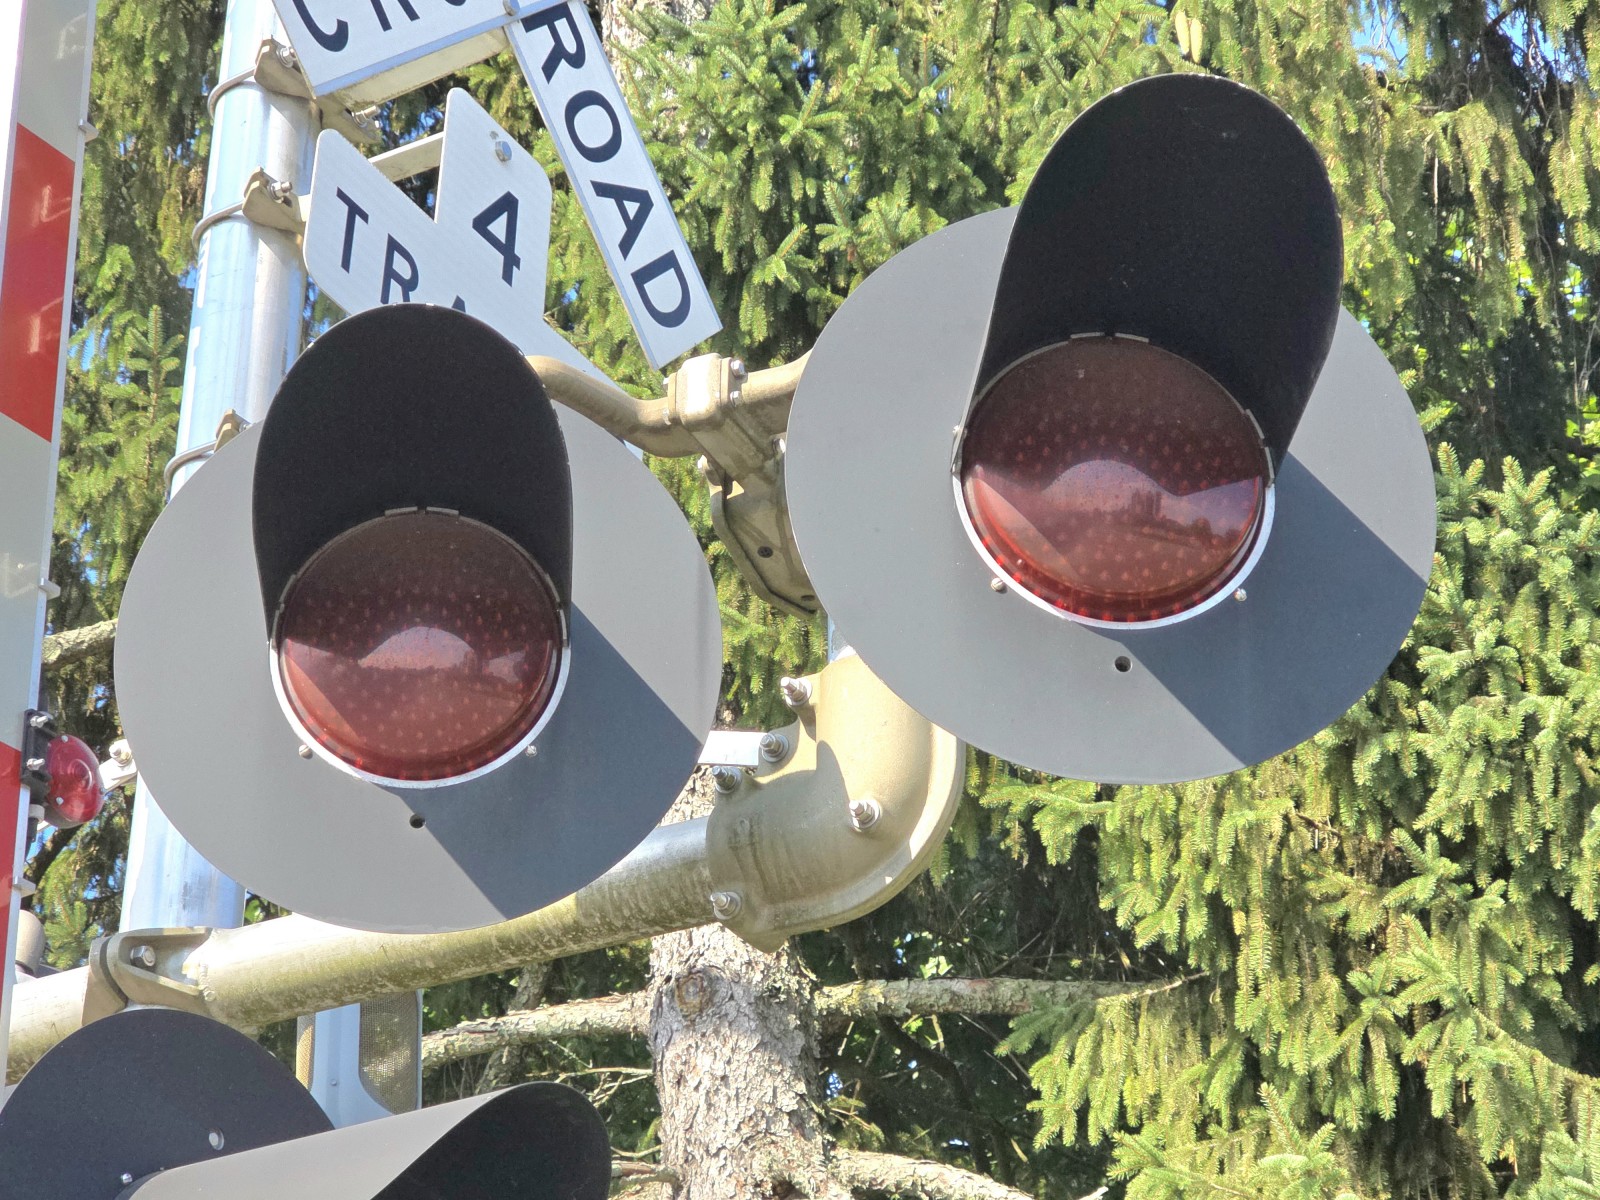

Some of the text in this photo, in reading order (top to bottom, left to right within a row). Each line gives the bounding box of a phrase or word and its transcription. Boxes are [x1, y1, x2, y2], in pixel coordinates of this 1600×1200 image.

[521, 2, 691, 328] ROAD
[336, 186, 467, 313] TR
[472, 190, 521, 288] 4
